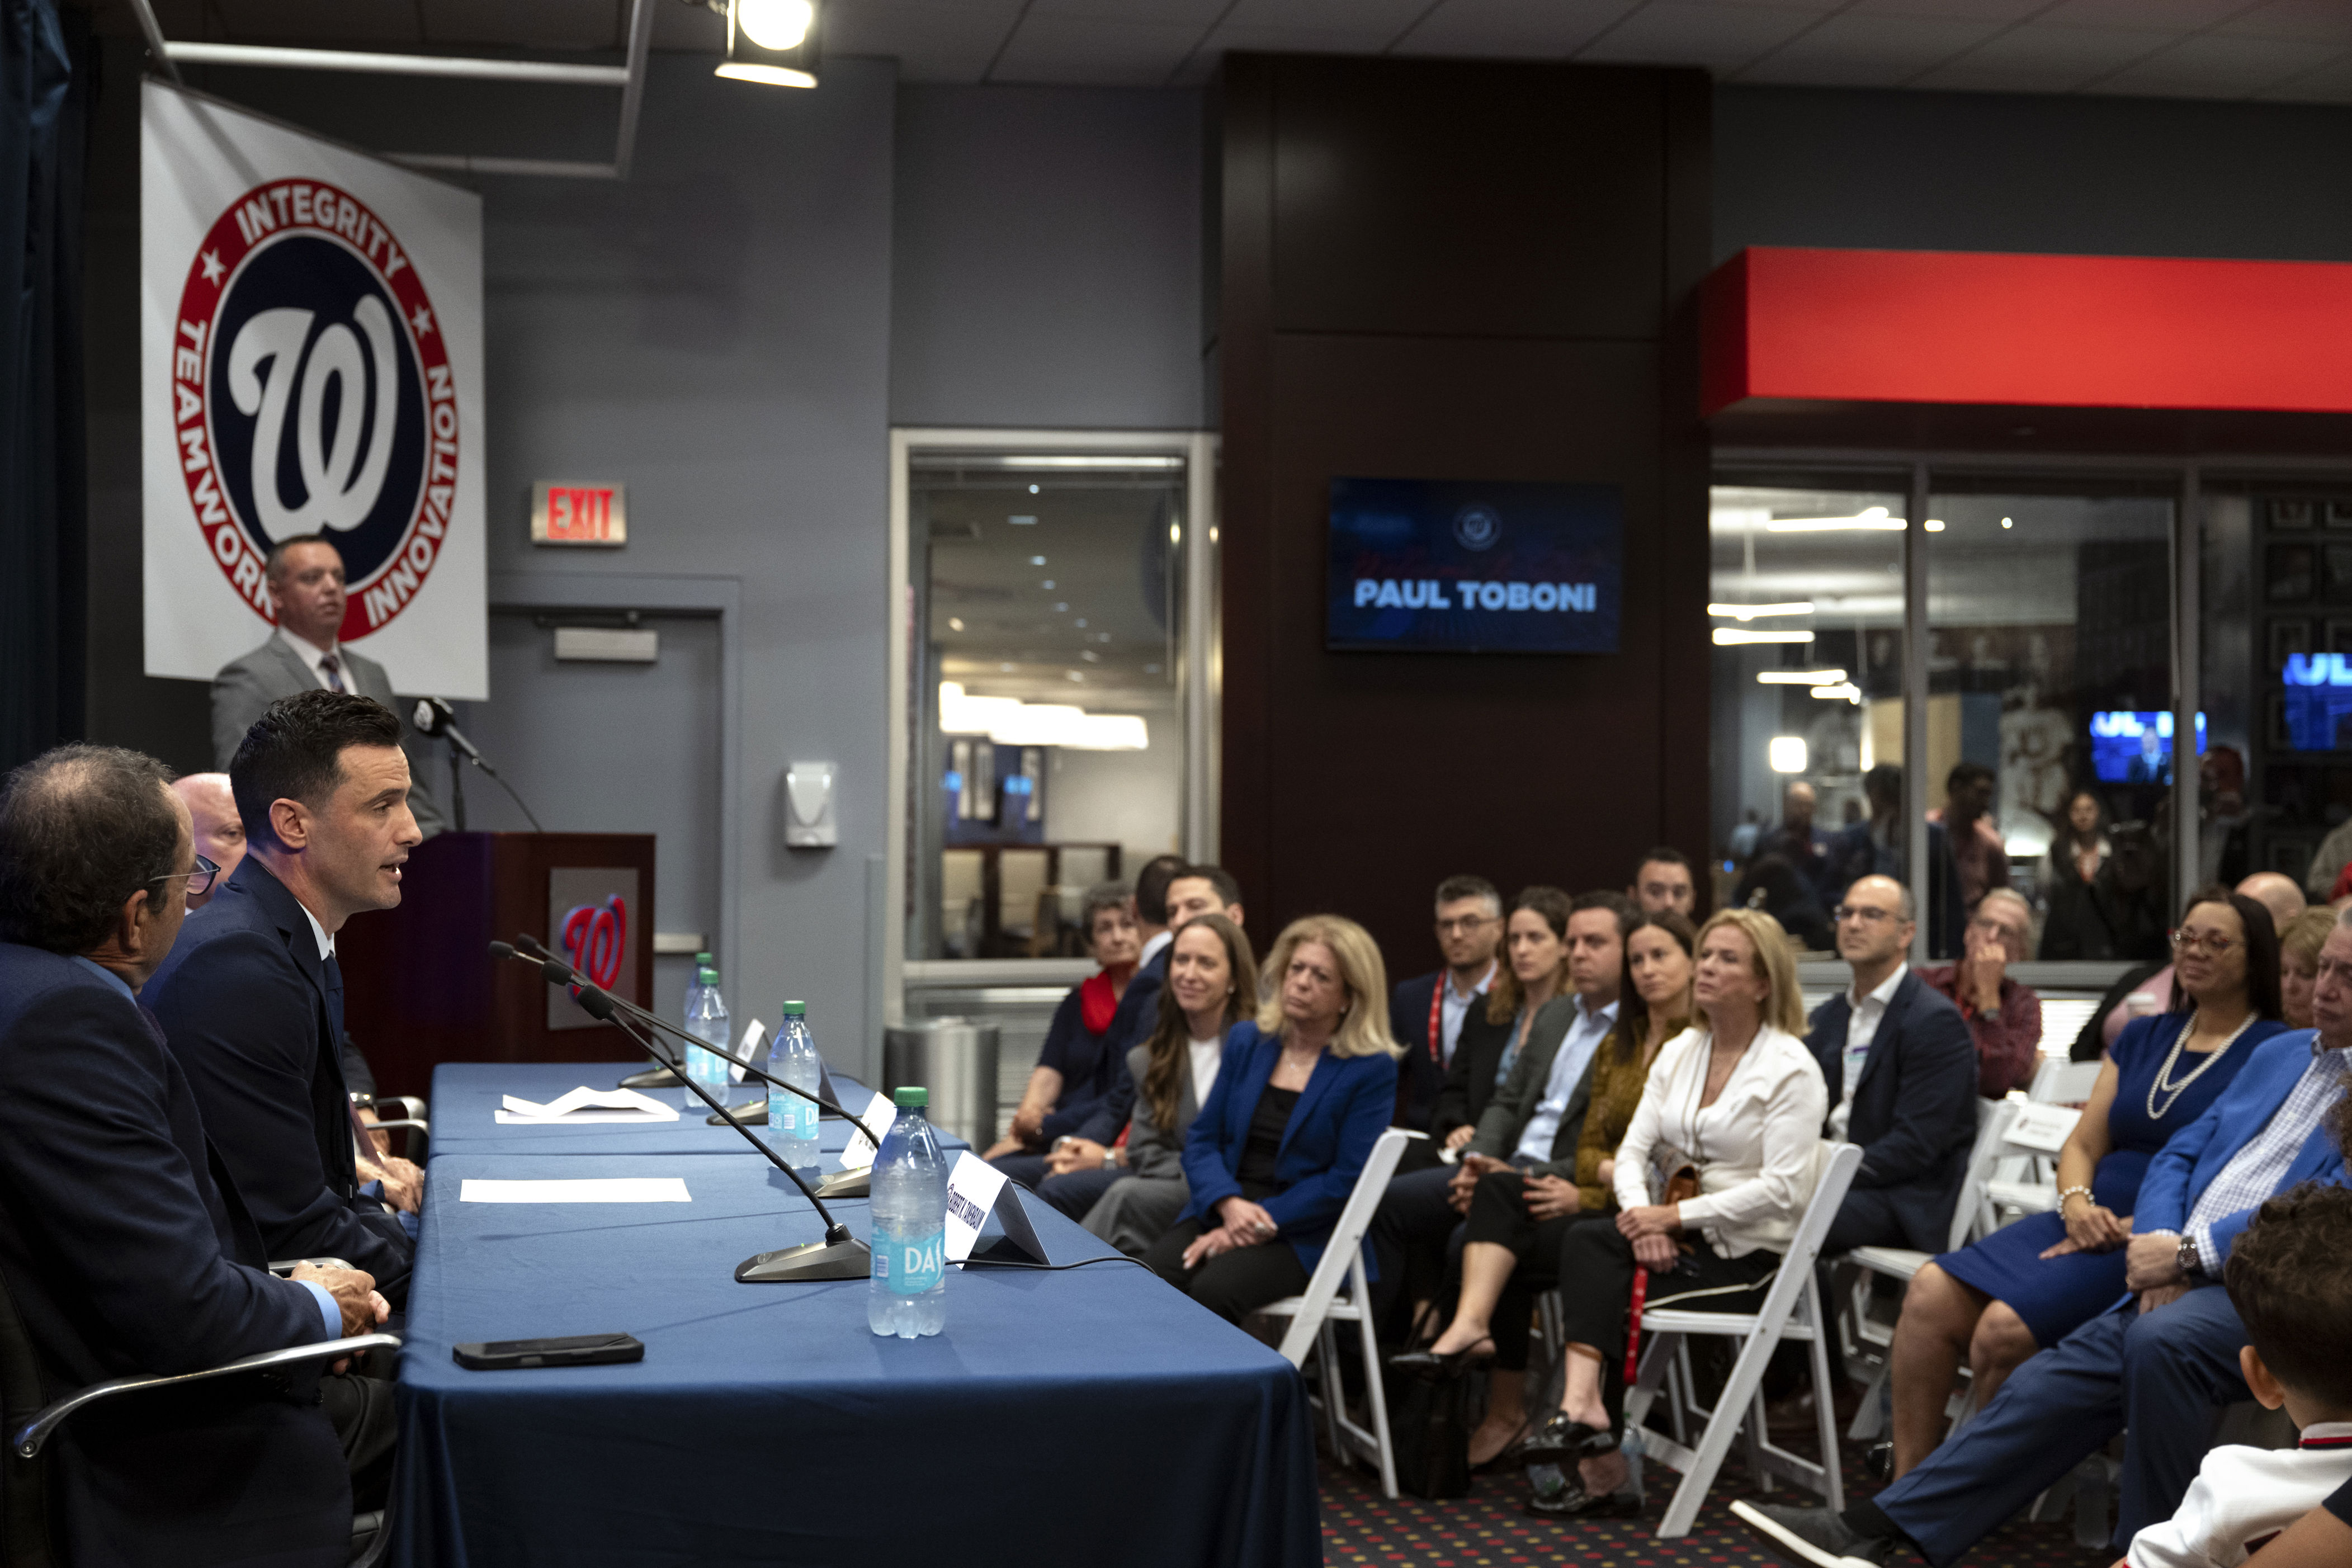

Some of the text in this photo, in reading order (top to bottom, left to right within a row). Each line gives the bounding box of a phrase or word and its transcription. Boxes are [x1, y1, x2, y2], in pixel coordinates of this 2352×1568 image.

[236, 186, 406, 280] INTEGRITY
[228, 294, 399, 544] W
[177, 318, 275, 618] TEAMWORK
[364, 365, 456, 627] INNOVATION
[547, 487, 615, 540] EXIT
[1354, 579, 1597, 612] PAUL TOBONI
[2283, 653, 2352, 686] UL
[2090, 711, 2145, 737] UL
[561, 894, 626, 1003] W
[905, 1238, 942, 1281] DAS
